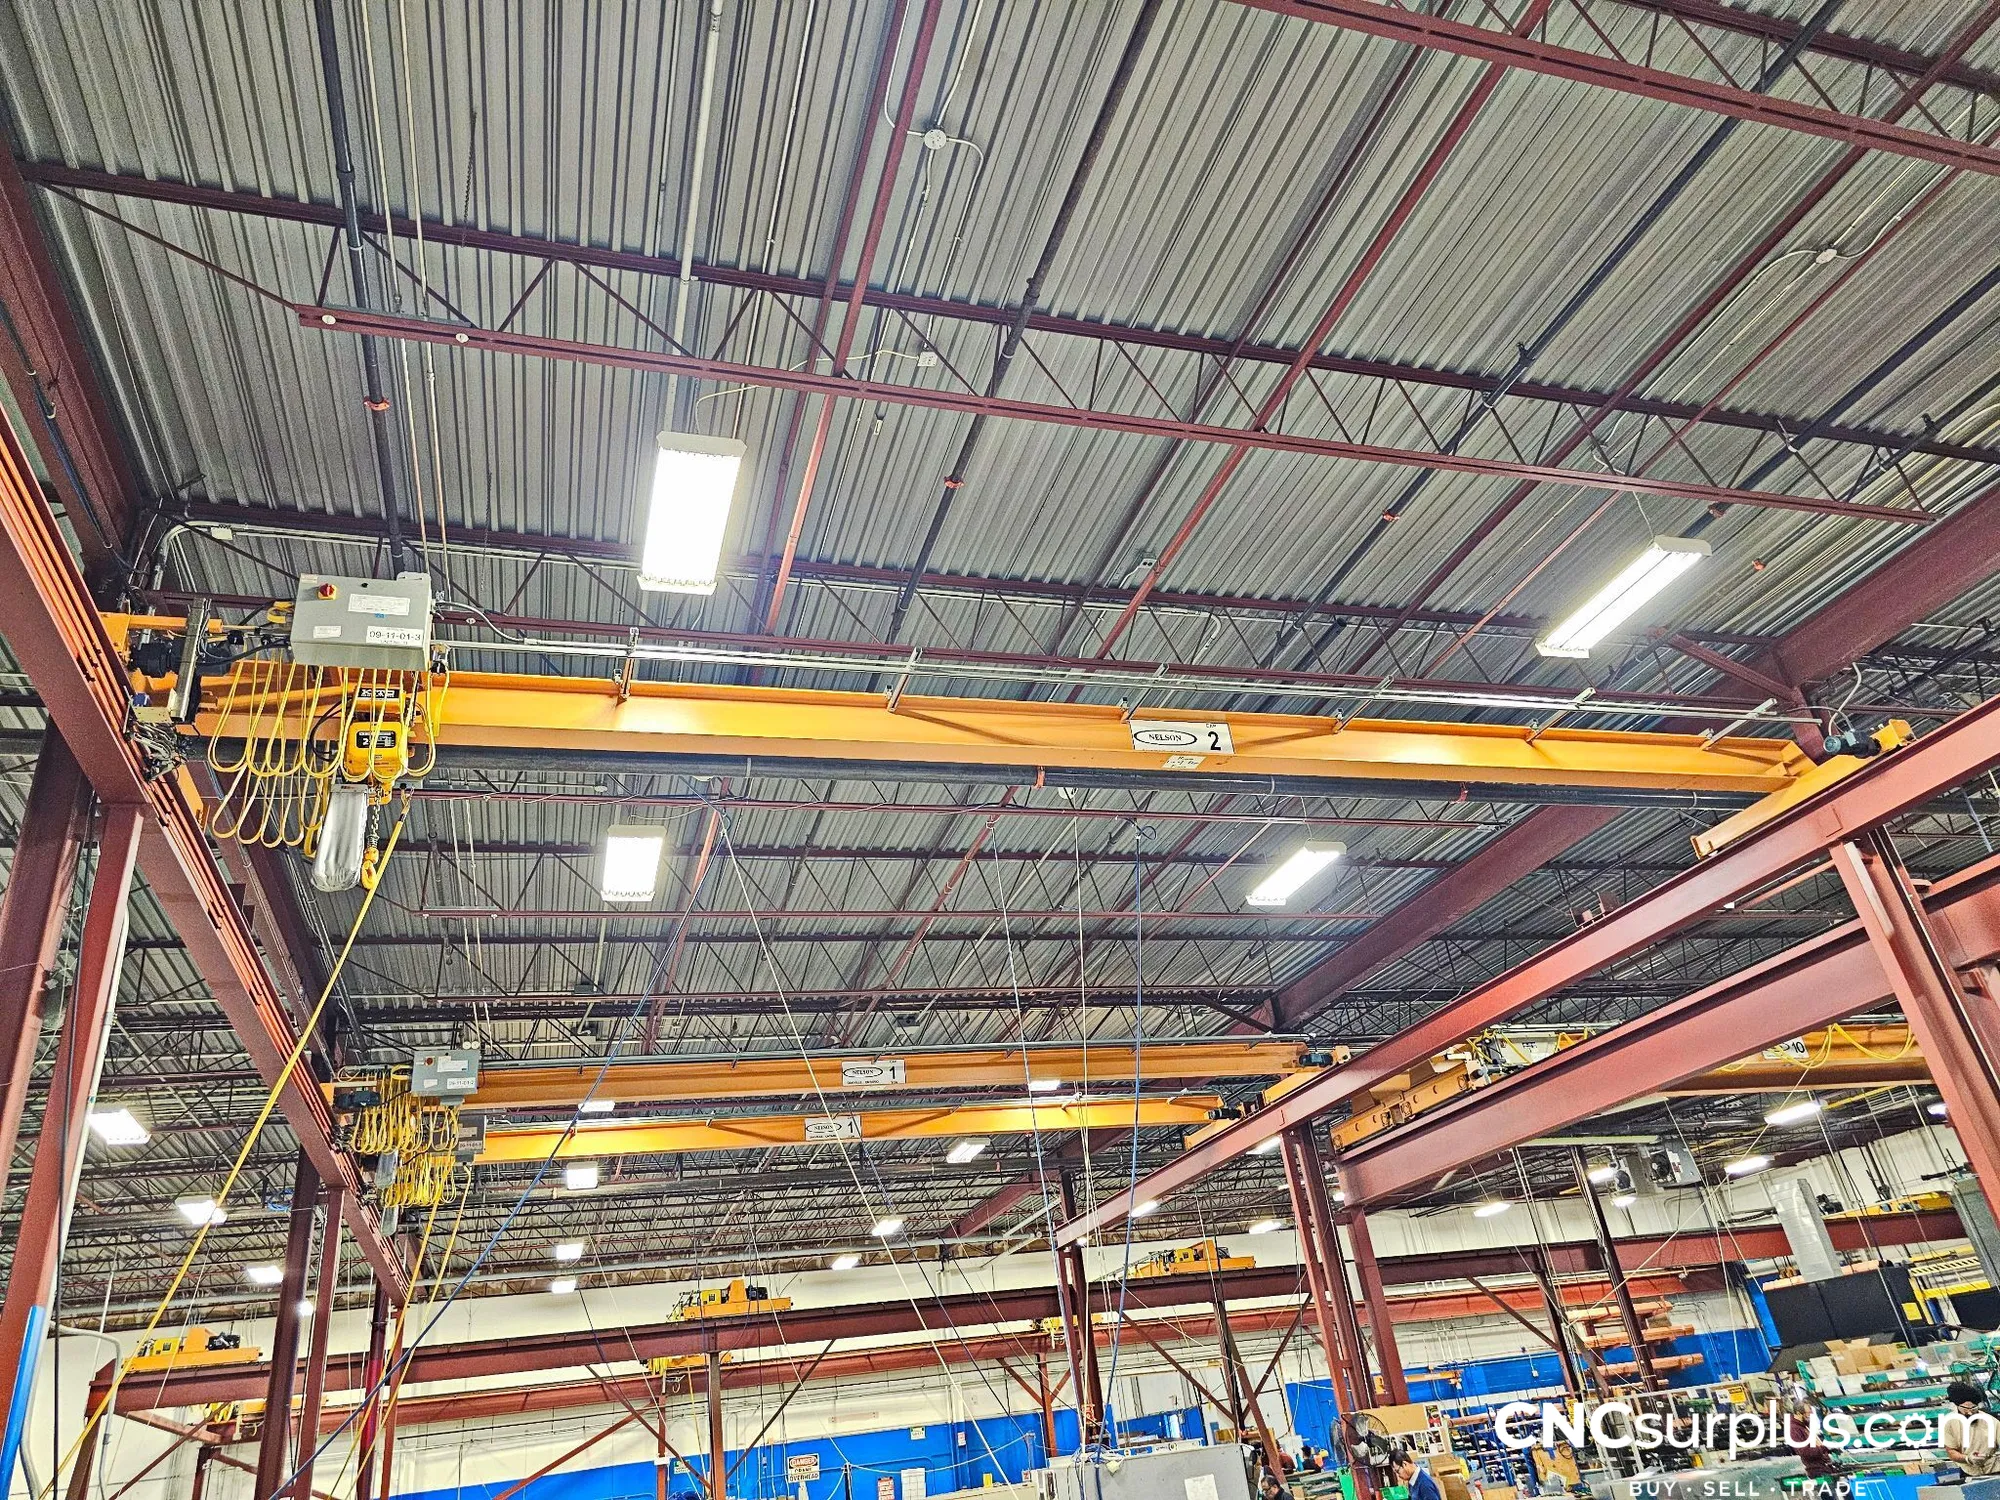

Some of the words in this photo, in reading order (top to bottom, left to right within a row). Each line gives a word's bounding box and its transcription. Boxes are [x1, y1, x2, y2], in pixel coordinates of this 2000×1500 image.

[1148, 733, 1182, 742] NELSON
[1208, 731, 1221, 750] 2
[1791, 1041, 1806, 1053] 10
[889, 1066, 896, 1079] 1
[848, 1121, 853, 1133] 1
